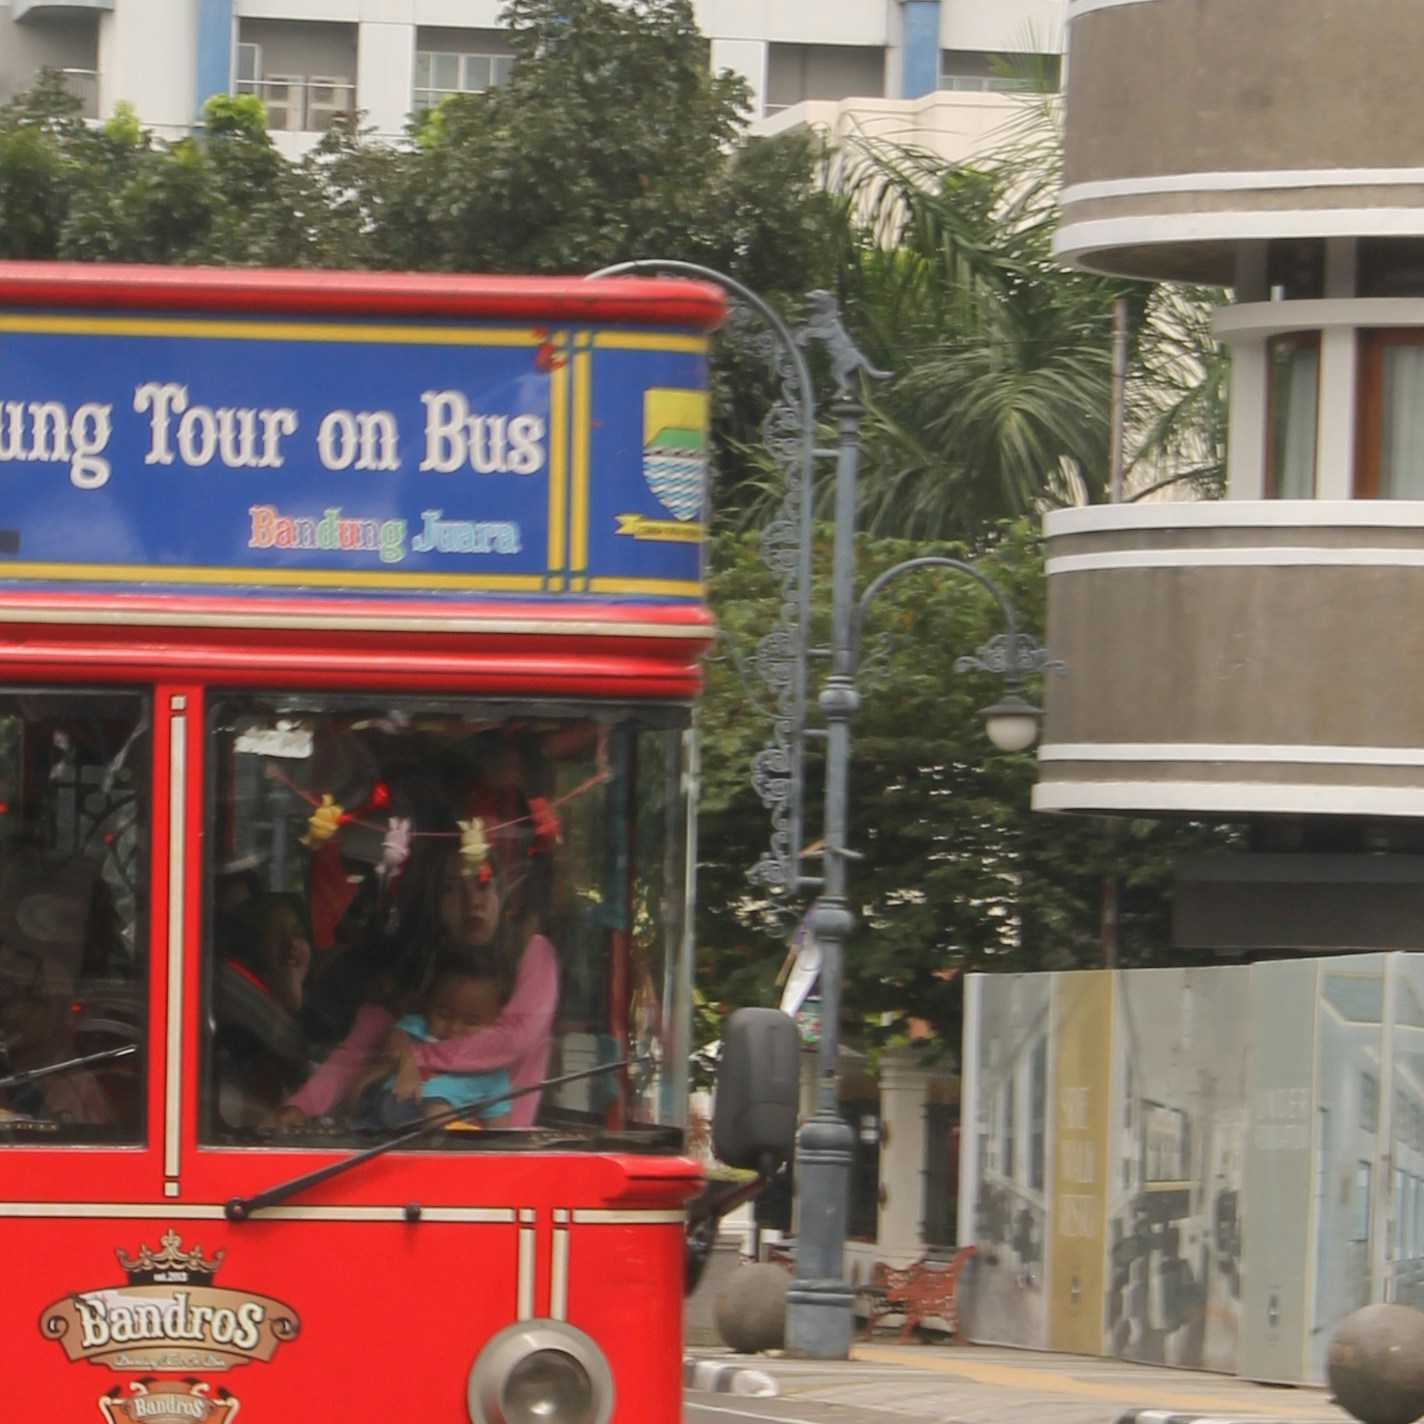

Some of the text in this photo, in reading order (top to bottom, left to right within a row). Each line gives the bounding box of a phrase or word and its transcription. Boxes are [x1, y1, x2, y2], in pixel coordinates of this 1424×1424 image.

[133, 381, 299, 468] Tour
[316, 409, 401, 471] on
[418, 389, 546, 475] Bus
[248, 504, 522, 563] Bandung Juara
